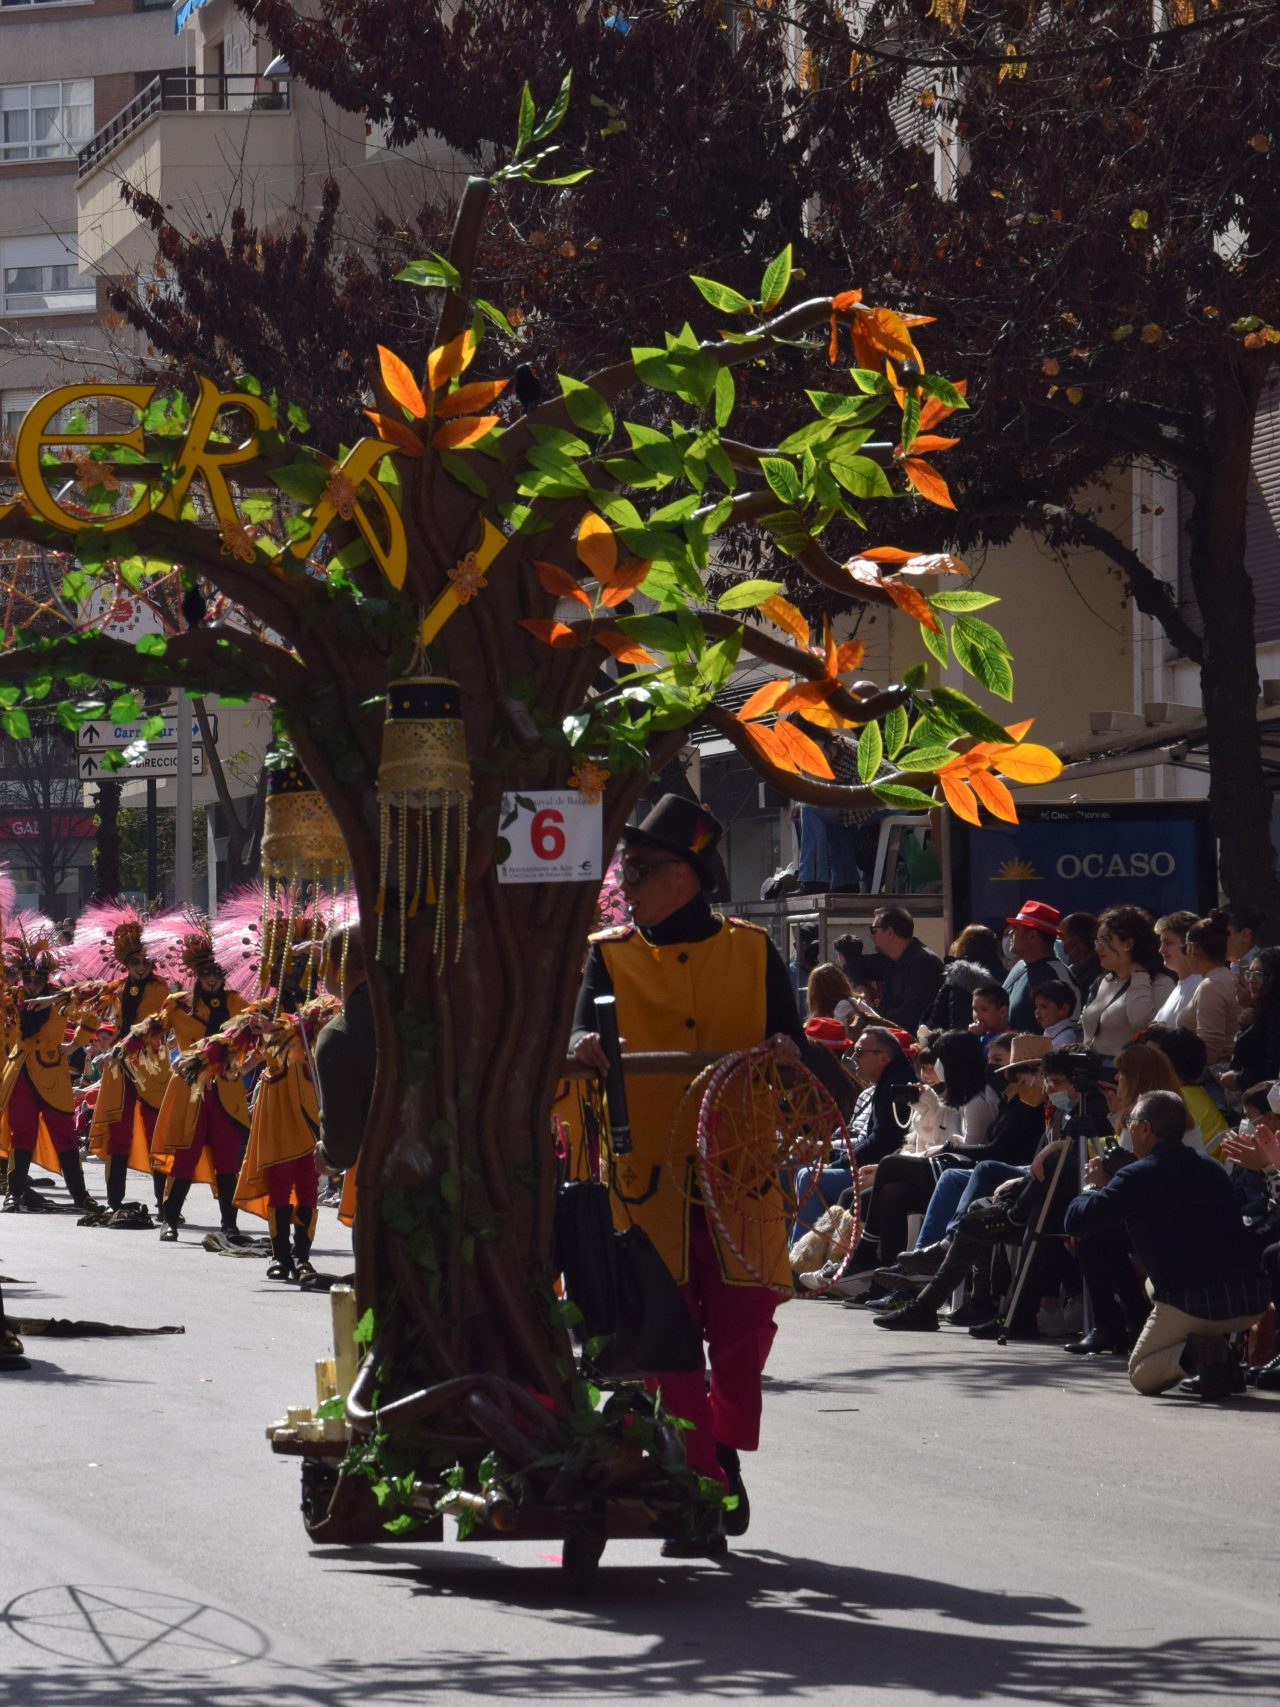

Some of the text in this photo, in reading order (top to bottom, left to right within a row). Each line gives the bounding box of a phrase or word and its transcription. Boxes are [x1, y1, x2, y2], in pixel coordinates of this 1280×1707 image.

[114, 727, 174, 739] Carrur
[530, 808, 566, 861] 6
[1056, 852, 1175, 879] OCASO
